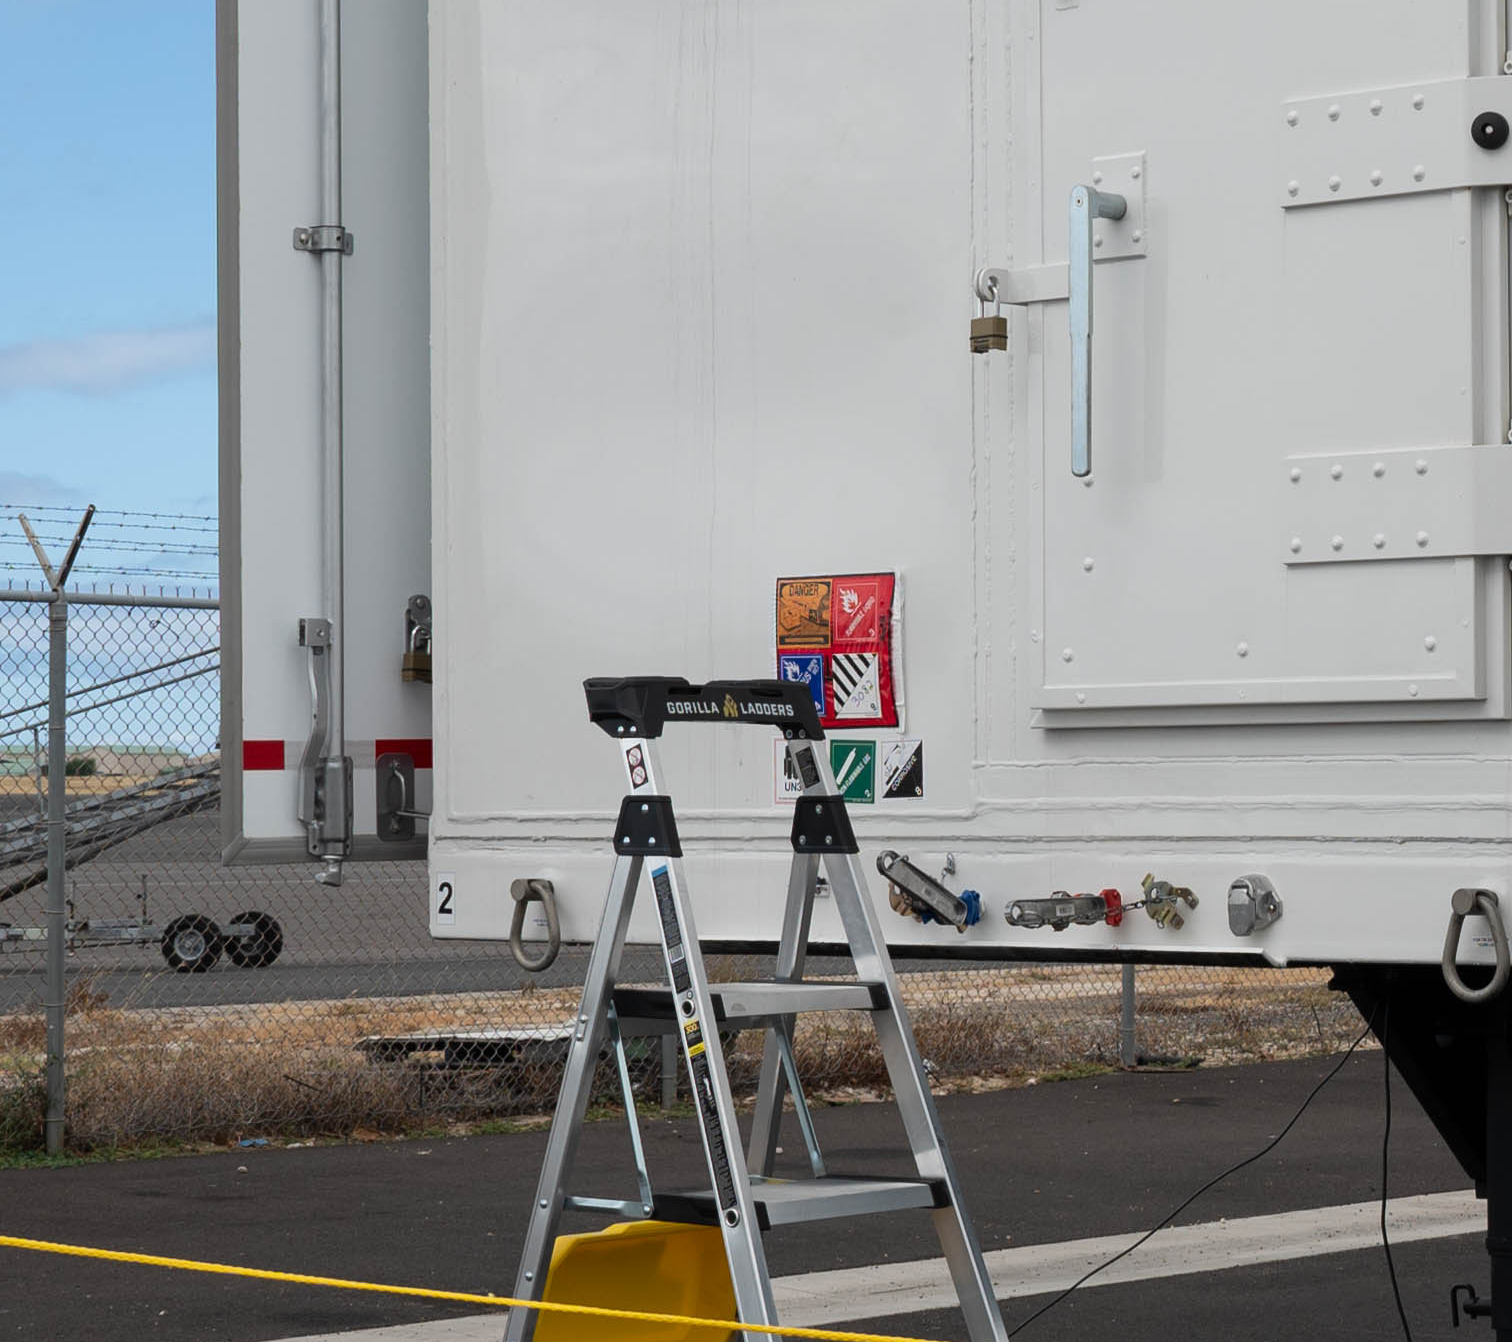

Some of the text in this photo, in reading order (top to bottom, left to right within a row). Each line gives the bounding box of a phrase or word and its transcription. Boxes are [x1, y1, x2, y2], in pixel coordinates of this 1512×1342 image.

[789, 584, 819, 596] DANGER
[666, 701, 795, 716] GORILLA LADDERS
[784, 782, 803, 792] UN3
[914, 786, 923, 796] 8
[438, 881, 453, 915] 2
